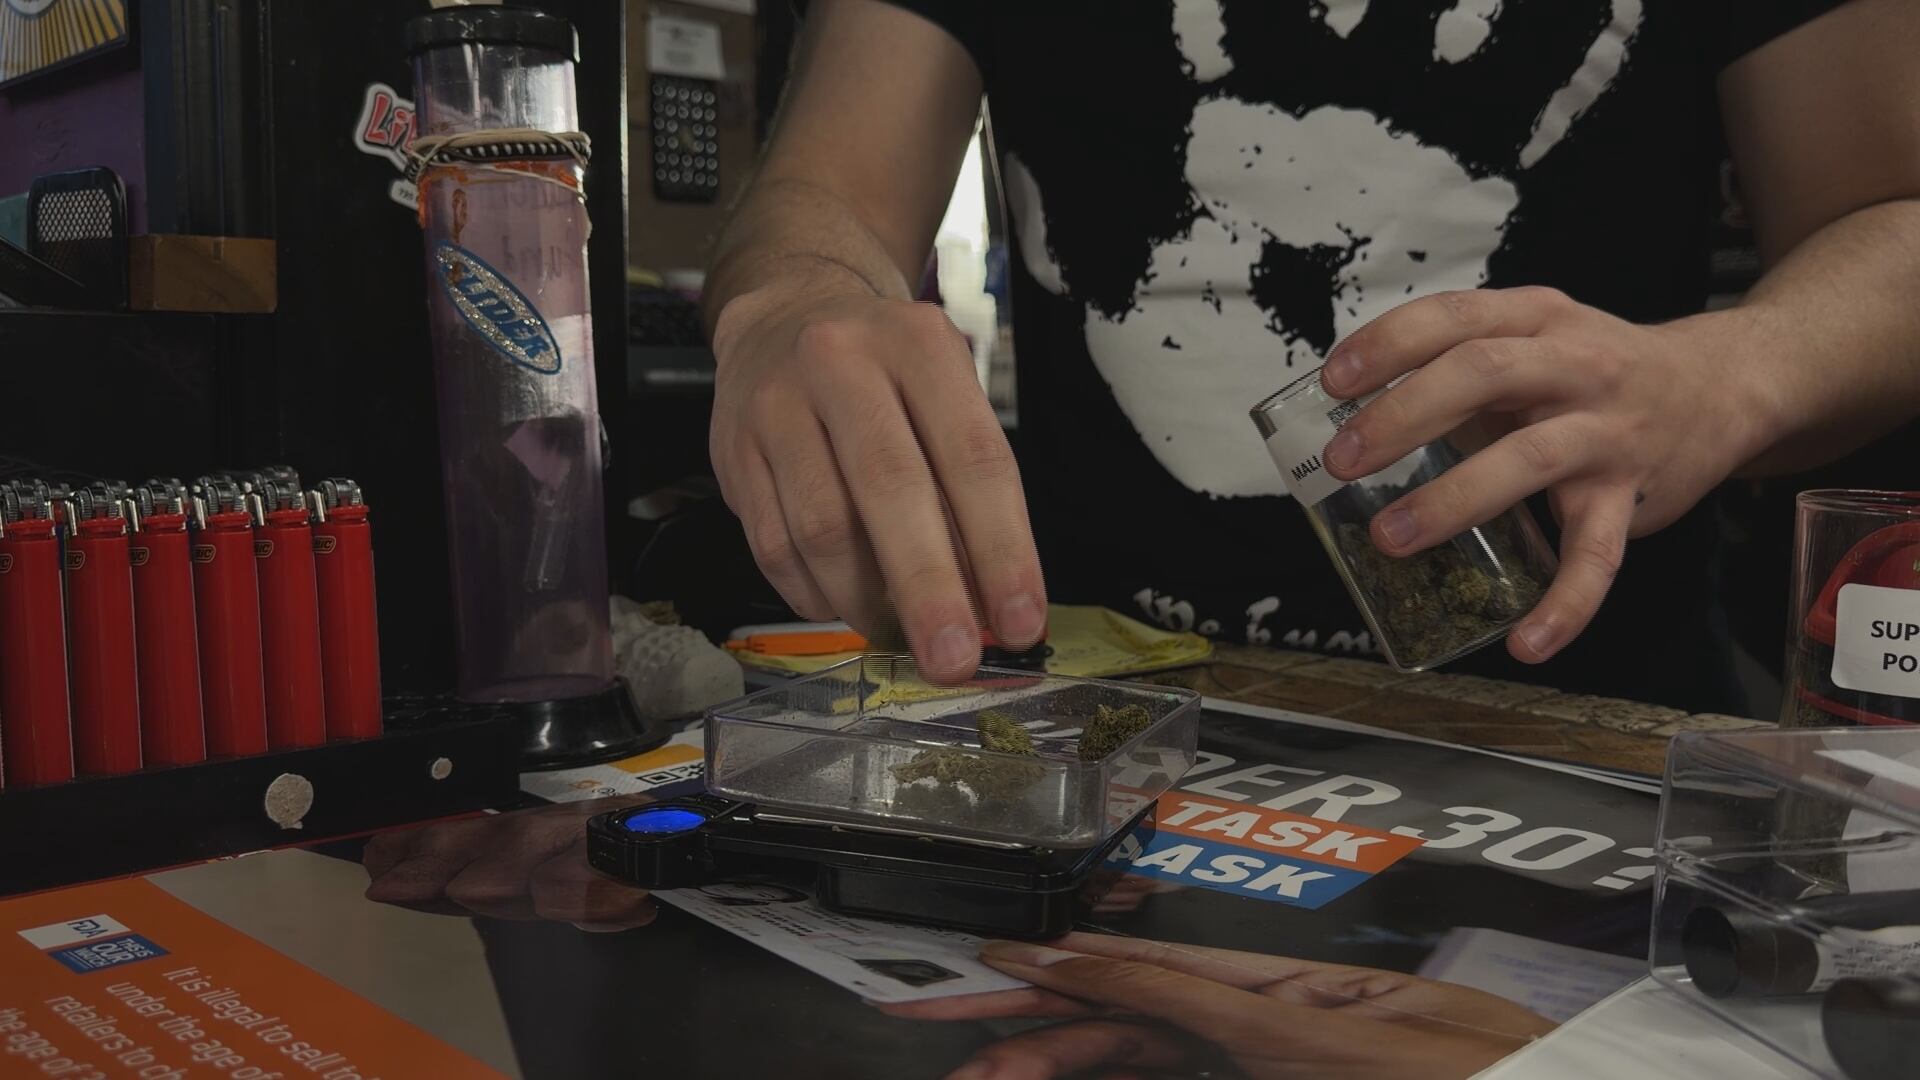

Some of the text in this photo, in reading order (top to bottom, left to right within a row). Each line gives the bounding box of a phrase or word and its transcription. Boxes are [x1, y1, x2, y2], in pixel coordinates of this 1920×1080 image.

[1871, 620, 1920, 640] SUP
[1882, 652, 1918, 673] PO
[1161, 801, 1387, 863] TASK
[1132, 843, 1336, 899] ASK
[66, 919, 109, 939] FDA
[90, 942, 136, 964] OUR
[162, 966, 200, 981] It
[177, 975, 213, 992] is
[195, 987, 281, 1031] illegal
[44, 995, 135, 1052] retailers
[117, 1046, 155, 1068] to
[105, 981, 176, 1018] under
[158, 1014, 206, 1042] the
[190, 1039, 246, 1069] age
[256, 1023, 293, 1044] to
[6, 1031, 60, 1060] age
[40, 1056, 95, 1075] of
[279, 1041, 347, 1072] sell
